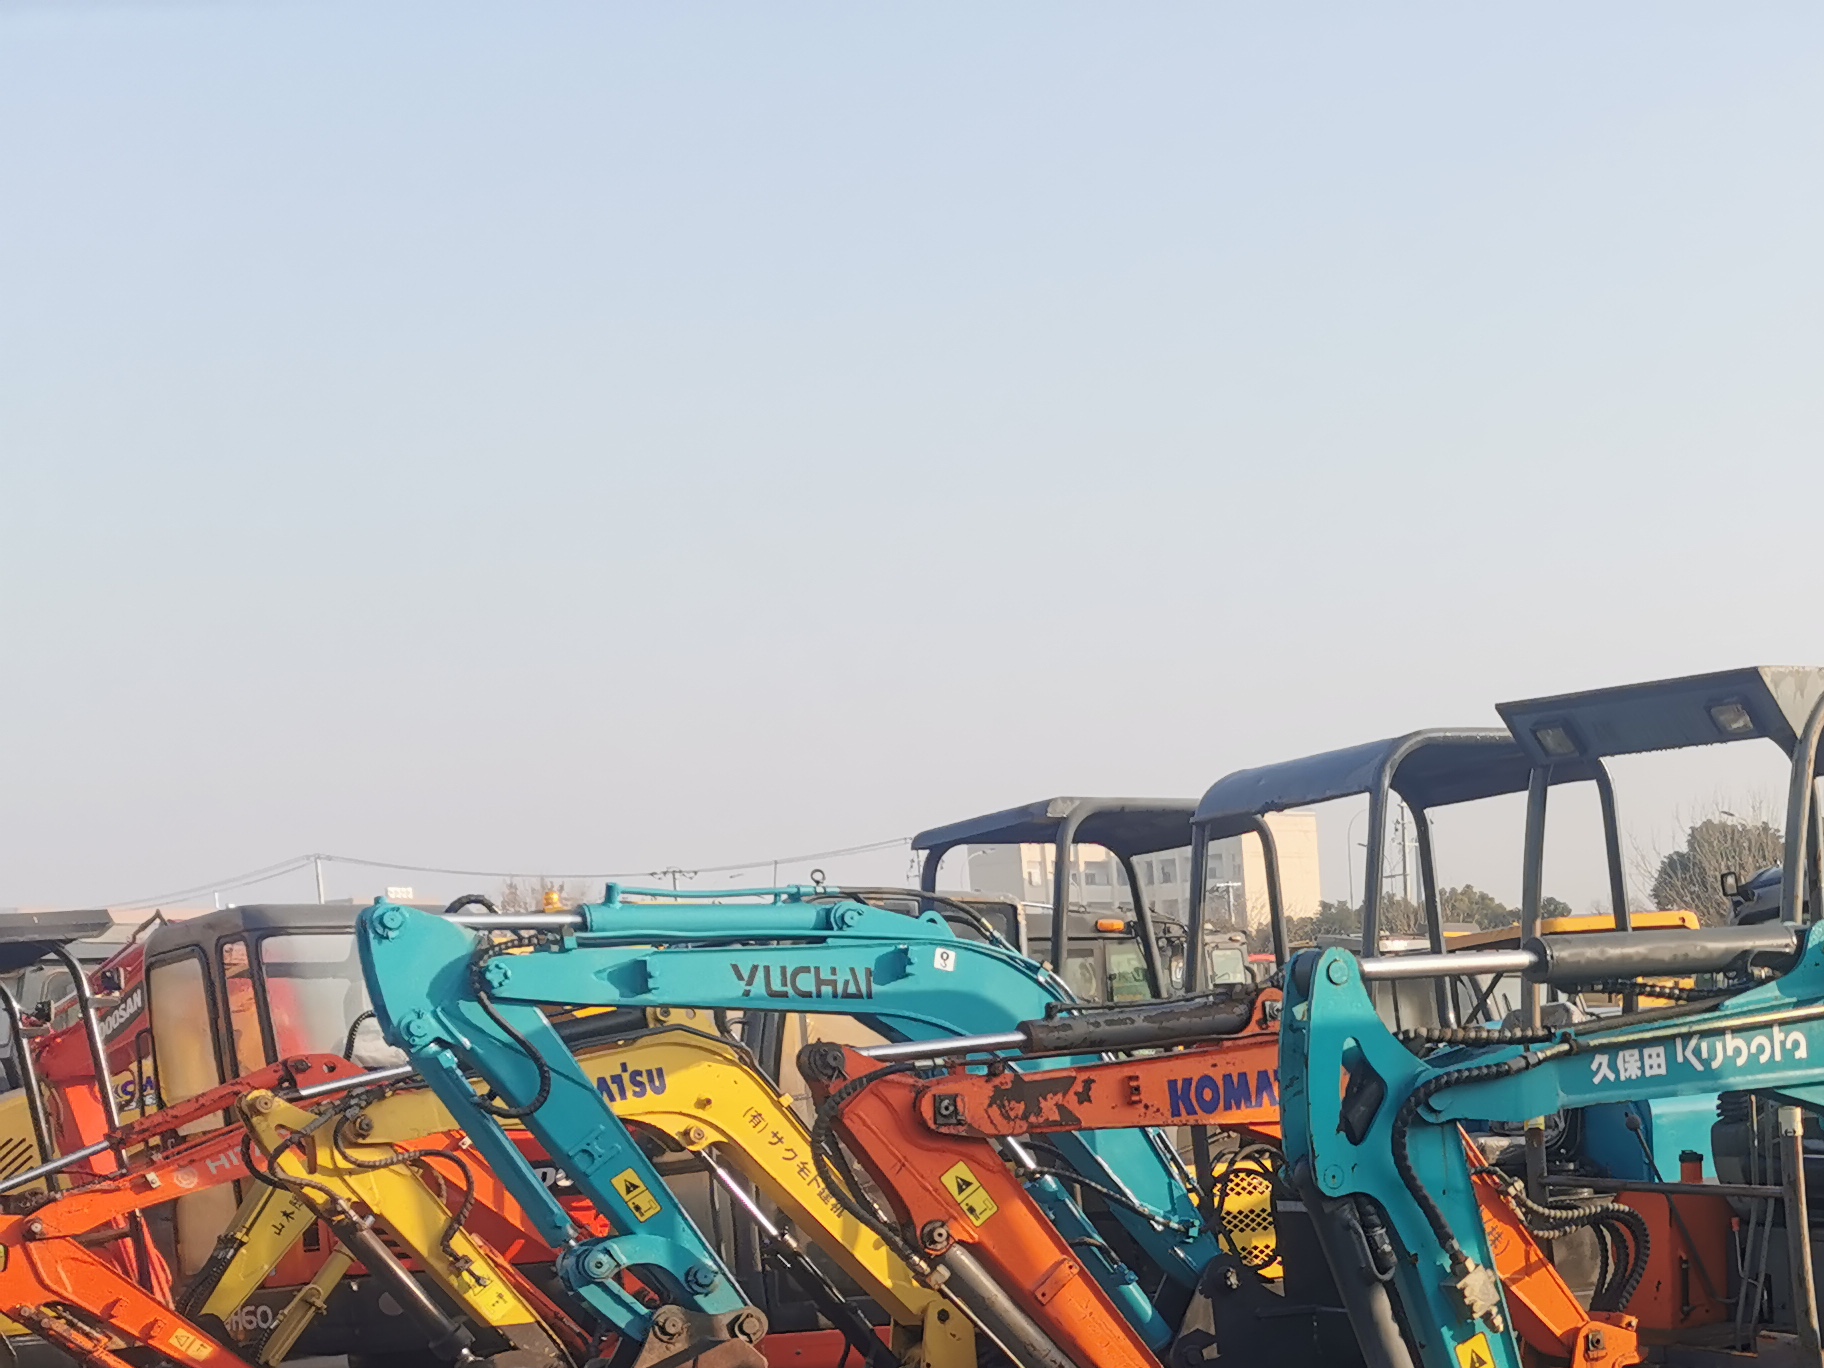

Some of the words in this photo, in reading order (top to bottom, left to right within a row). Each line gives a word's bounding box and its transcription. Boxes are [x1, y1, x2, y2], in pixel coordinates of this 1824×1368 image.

[730, 963, 873, 999] YUCHAI
[1591, 1045, 1667, 1085] 久保田
[1676, 1024, 1807, 1071] Kubota
[1167, 1069, 1280, 1118] KOMA
